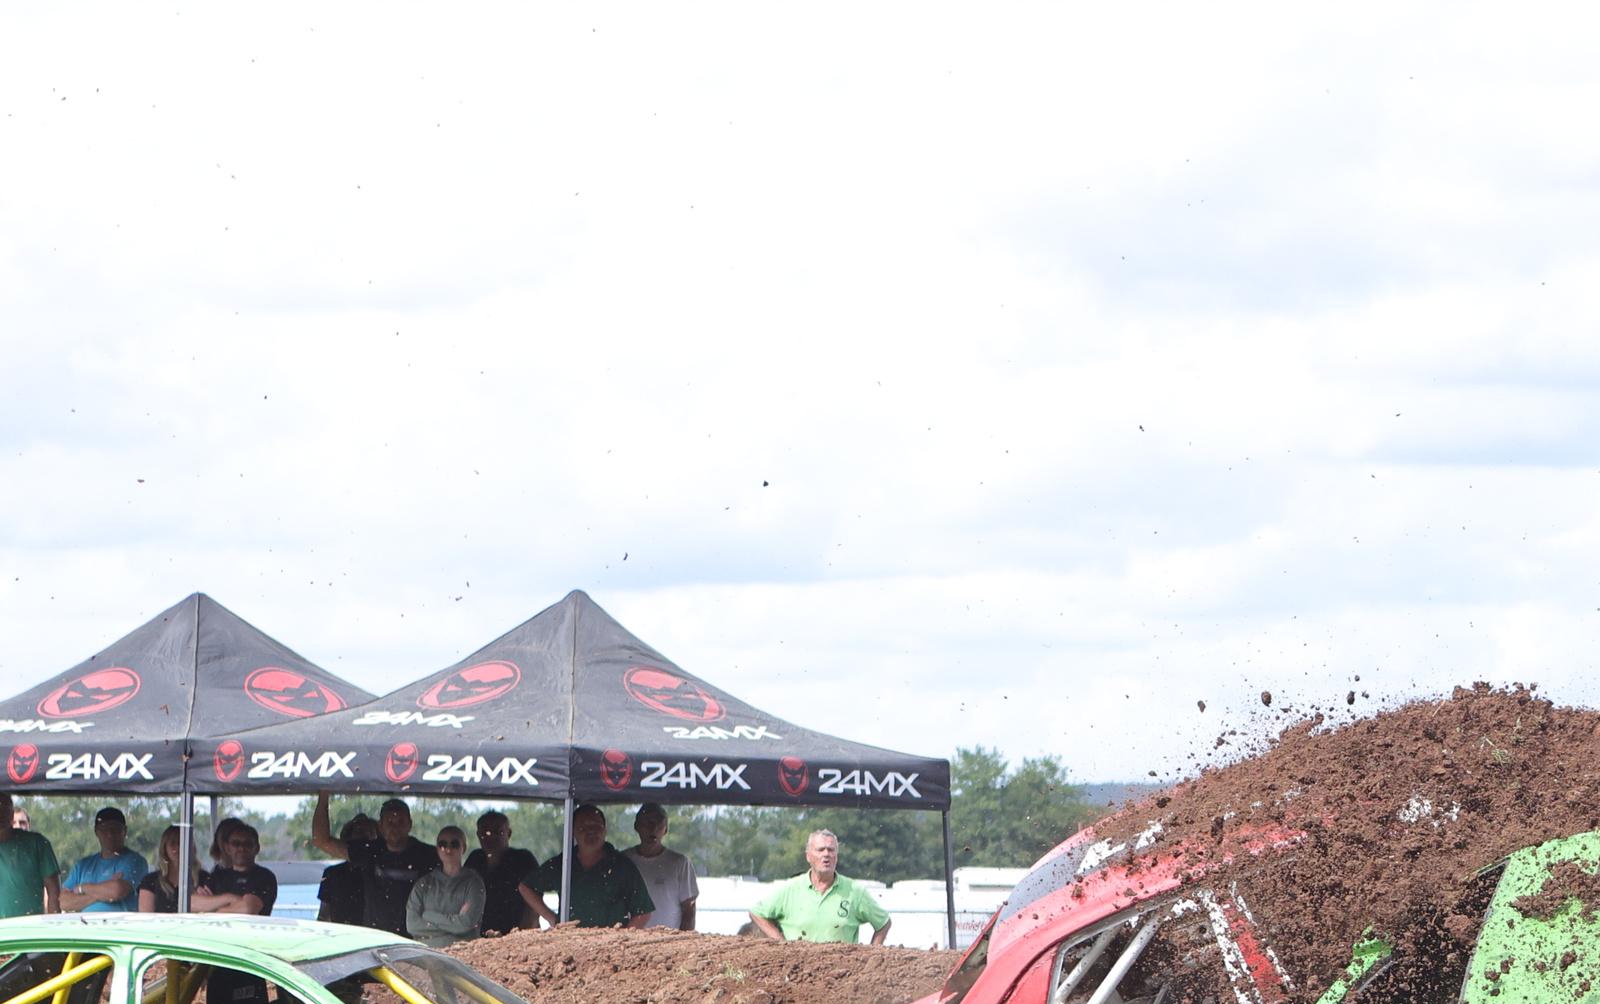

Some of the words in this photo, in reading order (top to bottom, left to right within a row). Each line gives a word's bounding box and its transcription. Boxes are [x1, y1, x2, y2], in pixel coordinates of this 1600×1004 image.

[352, 710, 476, 729] 24MX
[663, 725, 784, 741] 24MX
[45, 753, 154, 780] 24MX
[247, 751, 357, 778] 24MX
[422, 754, 539, 786] 24MX
[640, 761, 752, 789] 24MX
[818, 768, 922, 798] 24MX
